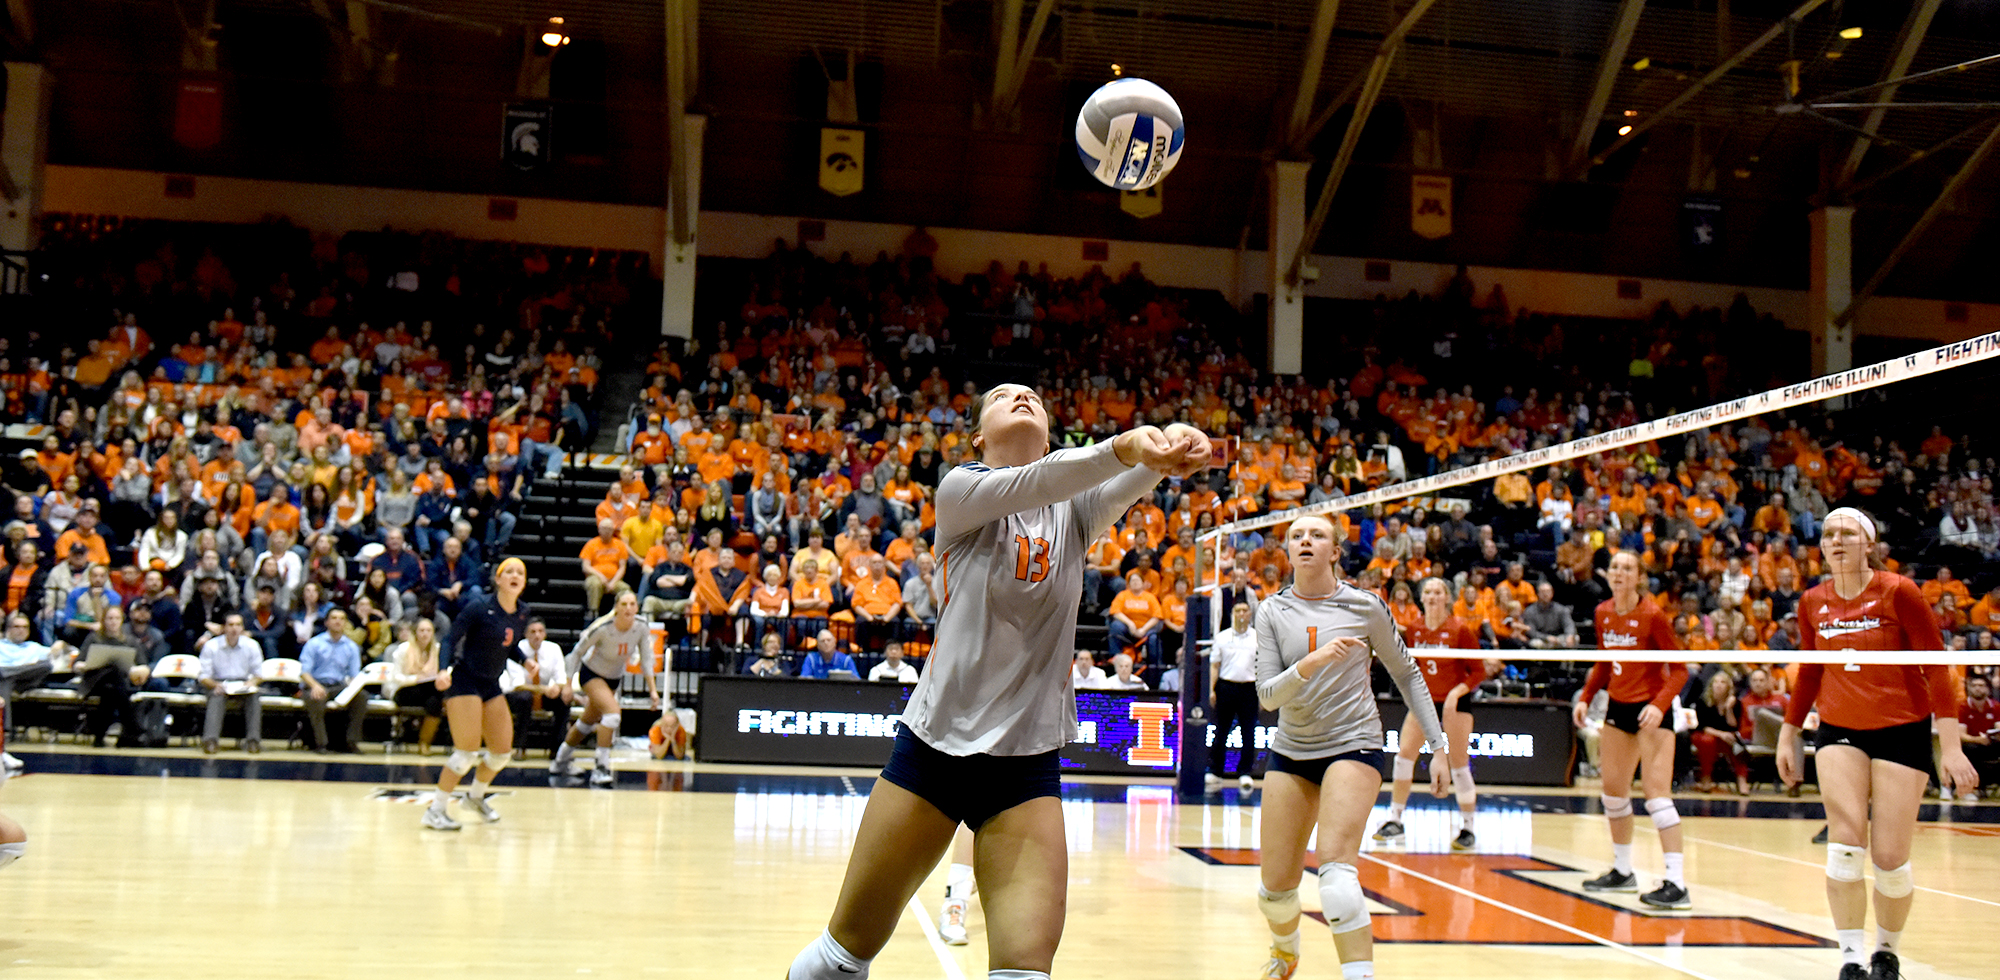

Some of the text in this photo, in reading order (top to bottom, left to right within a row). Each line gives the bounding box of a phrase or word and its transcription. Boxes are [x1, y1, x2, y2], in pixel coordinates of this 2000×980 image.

[1936, 334, 2000, 365] FIGHTIN
[1783, 363, 1887, 402] FIGHTING ILLINI
[1666, 399, 1747, 430] FIGHTING ILLINI
[1573, 433, 1610, 453] FIGHTING
[1014, 534, 1050, 583] 13
[502, 627, 514, 647] 3
[618, 643, 628, 656] 11
[1306, 626, 1318, 653] 1
[1427, 660, 1438, 675] 3
